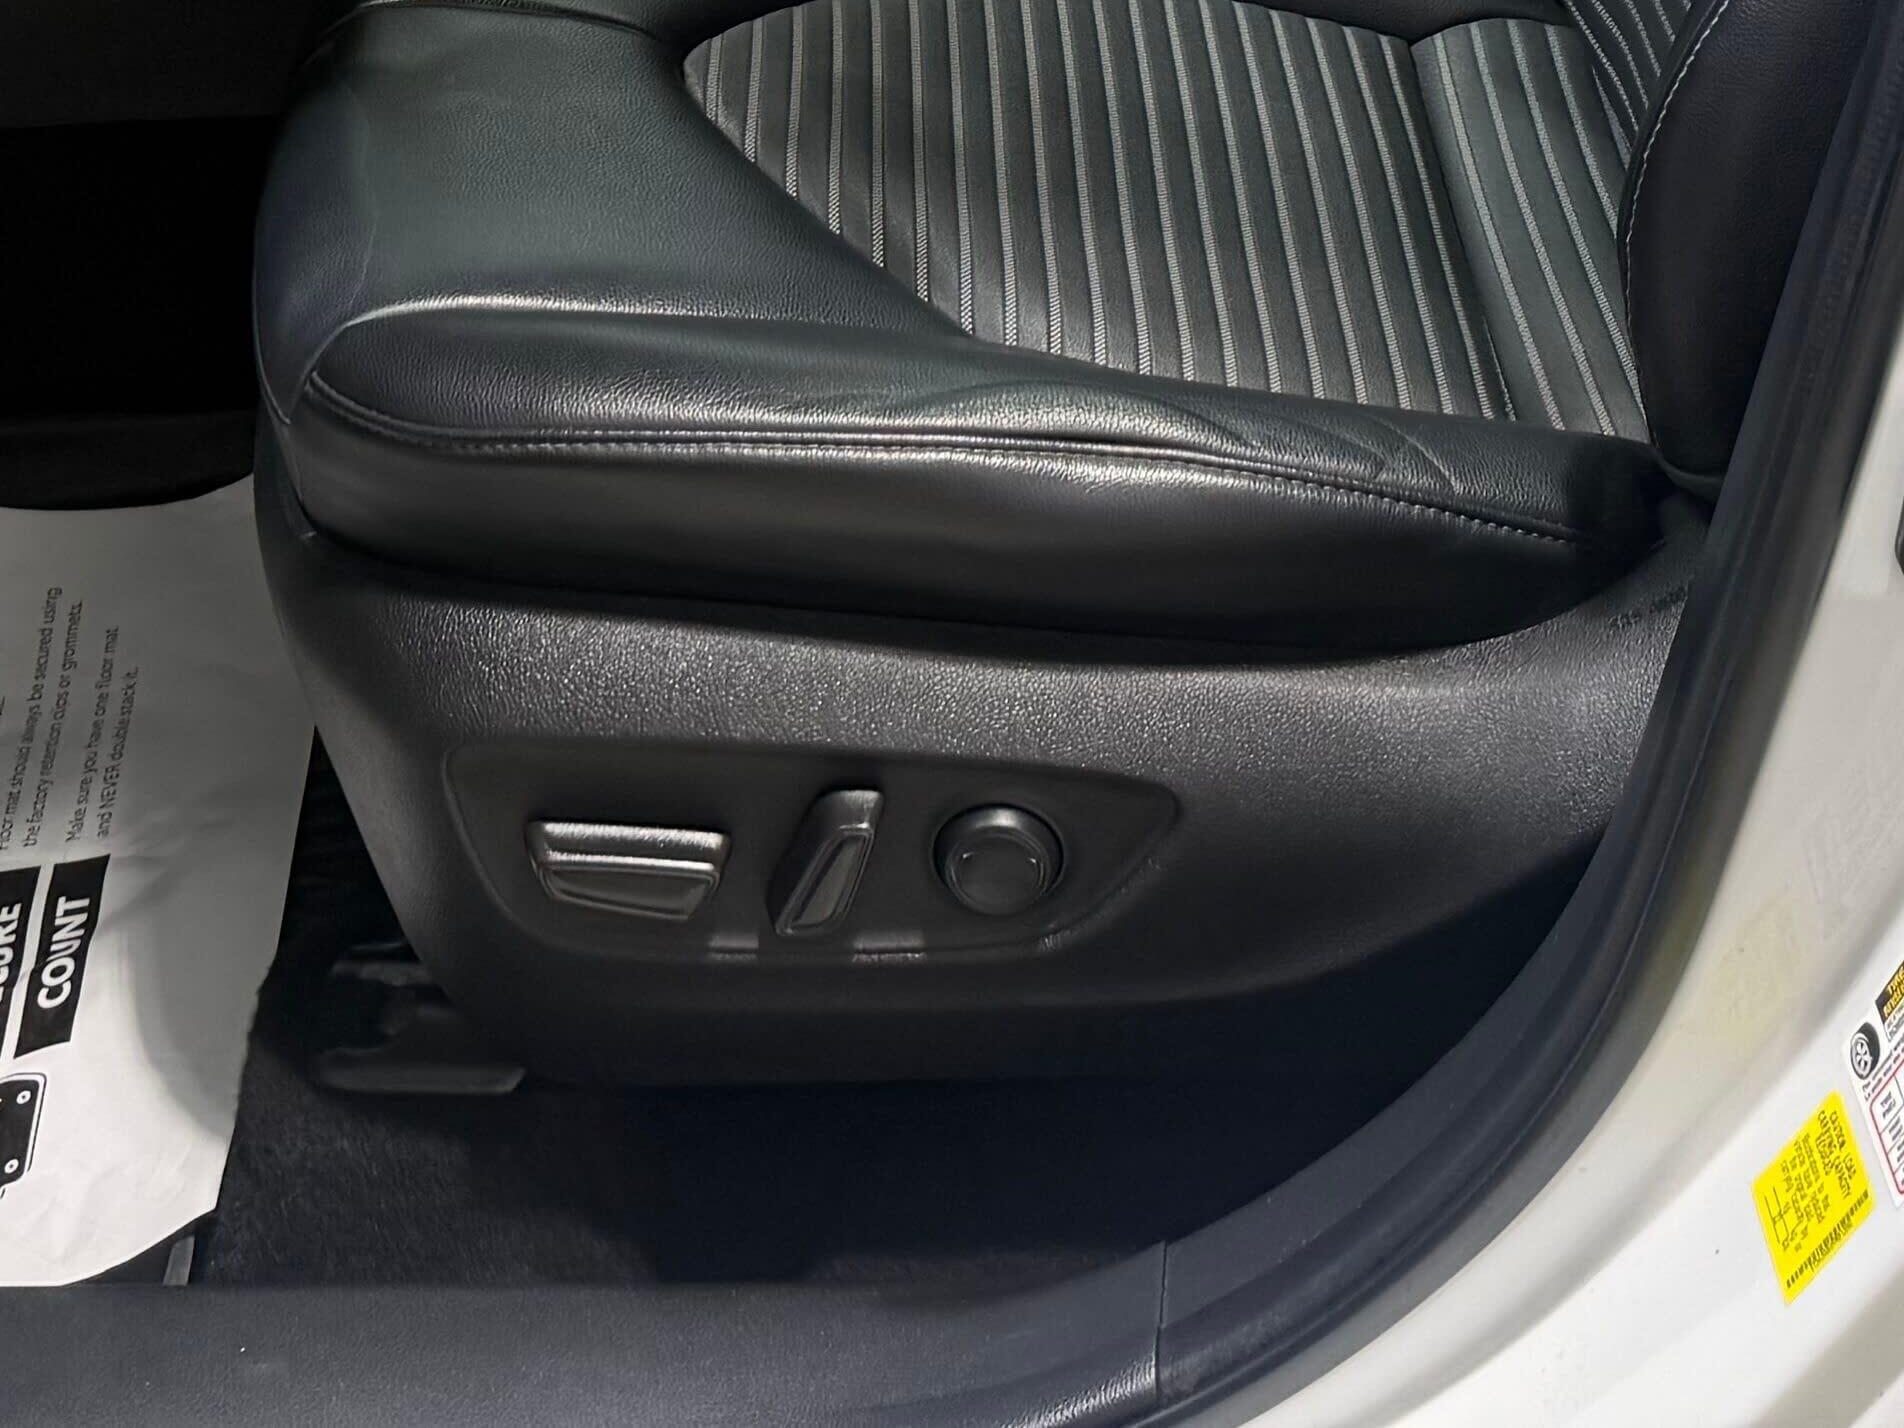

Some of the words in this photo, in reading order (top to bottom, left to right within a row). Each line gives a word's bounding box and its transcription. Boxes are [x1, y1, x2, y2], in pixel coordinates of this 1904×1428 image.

[42, 587, 63, 624] using
[35, 628, 53, 680] secured
[26, 684, 44, 701] be
[22, 824, 40, 847] the
[58, 674, 70, 688] or
[64, 806, 86, 842] Make
[77, 775, 92, 804] sure
[99, 764, 120, 809] NEVER
[97, 812, 112, 838] and
[37, 896, 90, 1009] COUNT
